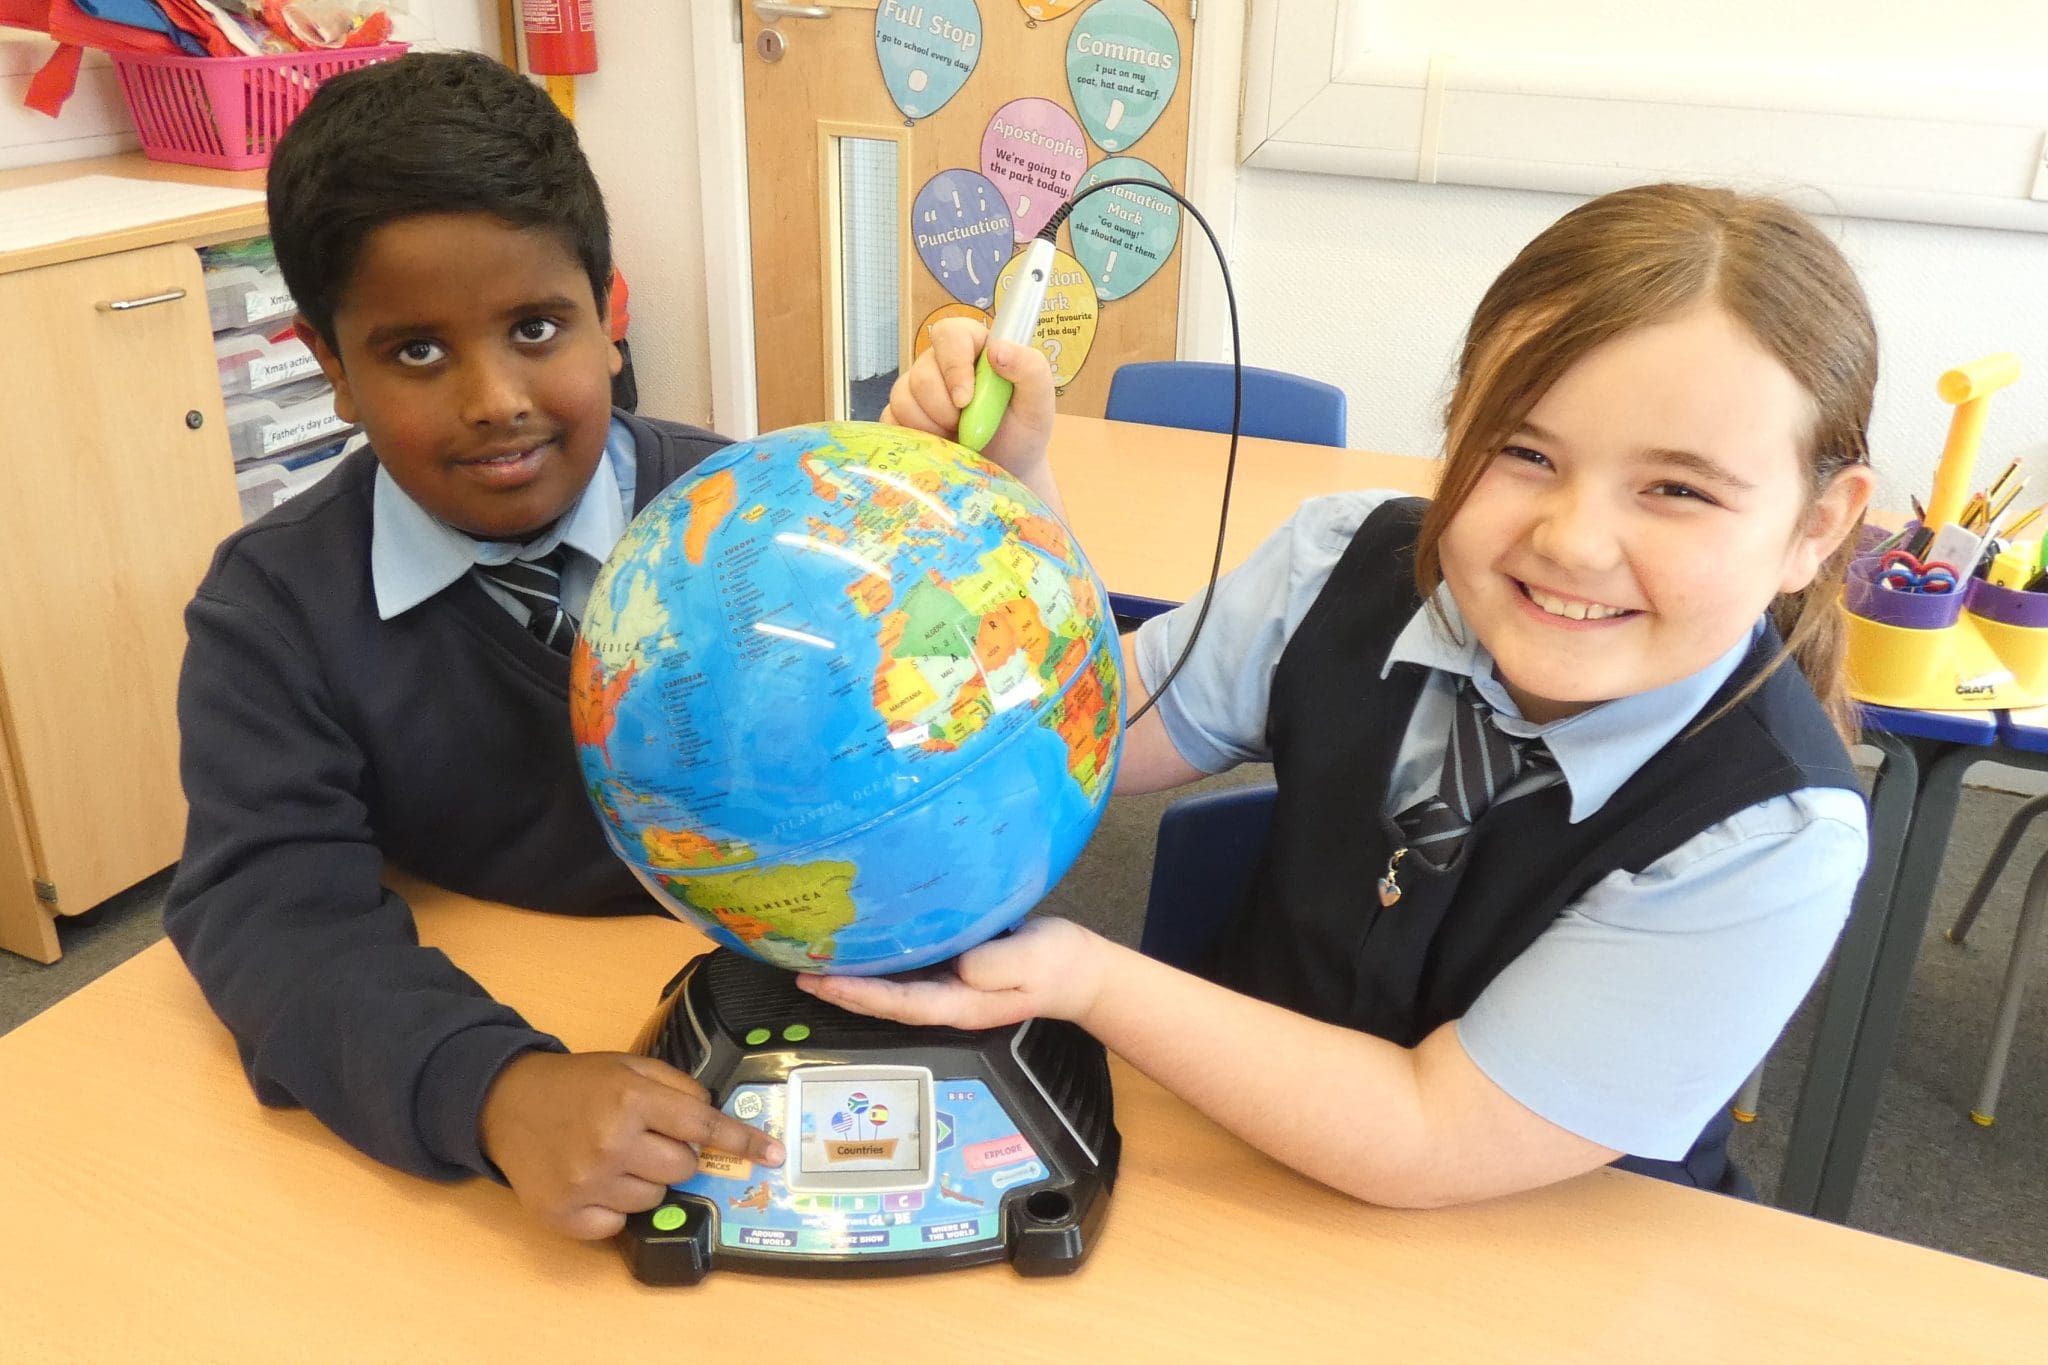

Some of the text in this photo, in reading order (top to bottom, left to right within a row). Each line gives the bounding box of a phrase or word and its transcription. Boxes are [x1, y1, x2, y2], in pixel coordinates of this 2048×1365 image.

[884, 0, 976, 51] Full Stop
[881, 34, 892, 43] go
[893, 36, 902, 46] to
[904, 41, 930, 57] school
[930, 51, 952, 66] every
[1076, 32, 1174, 70] Commas
[1101, 66, 1117, 75] put
[1118, 70, 1130, 78] on
[1131, 73, 1146, 83] my
[1077, 76, 1160, 101] coat, hat and scarf.
[993, 119, 1083, 158] Apostrophe
[995, 147, 1072, 182] We're going to
[990, 162, 1070, 198] the park today.
[1107, 202, 1143, 226] Mark
[918, 217, 1010, 248] Punctuation
[1075, 222, 1158, 260] she shouted at them.
[270, 293, 292, 306] Xma
[1040, 292, 1070, 312] ark
[1056, 312, 1093, 325] favourite
[1037, 325, 1081, 339] of the day?
[264, 361, 288, 376] Xmas
[271, 414, 339, 443] Father's day car
[924, 621, 947, 640] ALGERIA
[1955, 684, 1995, 696] CRAFT
[888, 689, 923, 713] MAURITANIA
[754, 891, 822, 912] AMERICA
[837, 1145, 884, 1156] Countries
[984, 1143, 1023, 1160] EXPLORE
[705, 1161, 731, 1171] PACKS
[898, 1195, 909, 1208] C
[751, 1230, 785, 1238] AROUND
[929, 1229, 976, 1241] THE WORLD
[931, 1222, 970, 1234] WHERE IN
[745, 1236, 792, 1247] THE WORLD
[859, 1234, 885, 1243] SHOW
